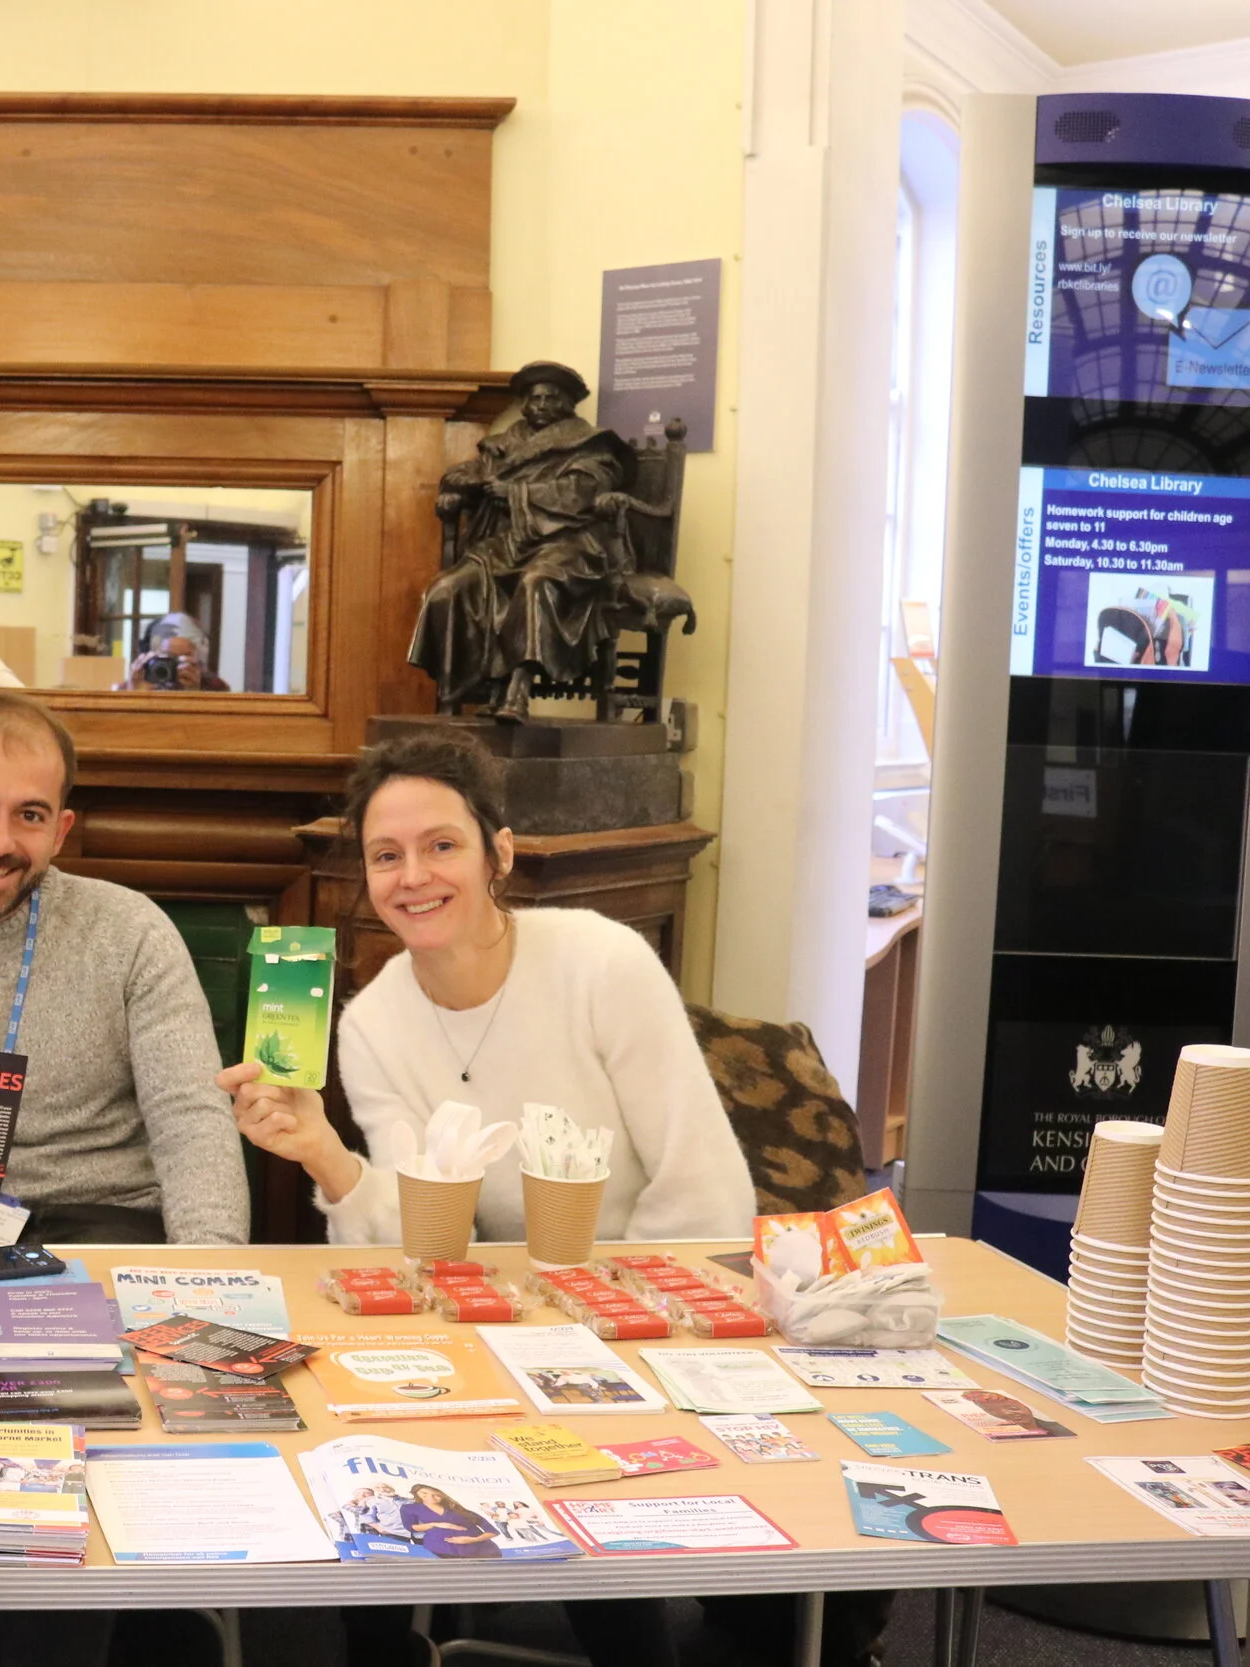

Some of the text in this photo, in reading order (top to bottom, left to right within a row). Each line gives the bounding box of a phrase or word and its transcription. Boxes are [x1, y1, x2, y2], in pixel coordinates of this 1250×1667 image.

[1103, 193, 1218, 215] Chelsea Library
[1060, 225, 1238, 244] Sign up to receive our newsletter
[1028, 240, 1047, 345] Resources
[1175, 360, 1250, 376] E-Newslette
[1088, 473, 1203, 495] Chelsea Library
[1047, 504, 1233, 525] Homework support for children age
[1046, 521, 1106, 533] seven to 11
[1045, 537, 1168, 555] Monday, 4.30 to 6.30pm
[1014, 506, 1035, 637] Events/offers
[1044, 554, 1183, 572] Saturday, 10.30 to 11.30am
[262, 1003, 284, 1014] mint
[1034, 1112, 1055, 1123] THE
[1057, 1113, 1091, 1124] ROYAL
[1032, 1131, 1092, 1148] KENSI
[1030, 1155, 1076, 1173] AND
[850, 1218, 889, 1238] TWININGS
[117, 1273, 260, 1287] MINI COMMS
[518, 1439, 557, 1448] stand
[523, 1443, 583, 1453] together
[343, 1456, 511, 1484] flu vaccination
[629, 1500, 679, 1508] Support
